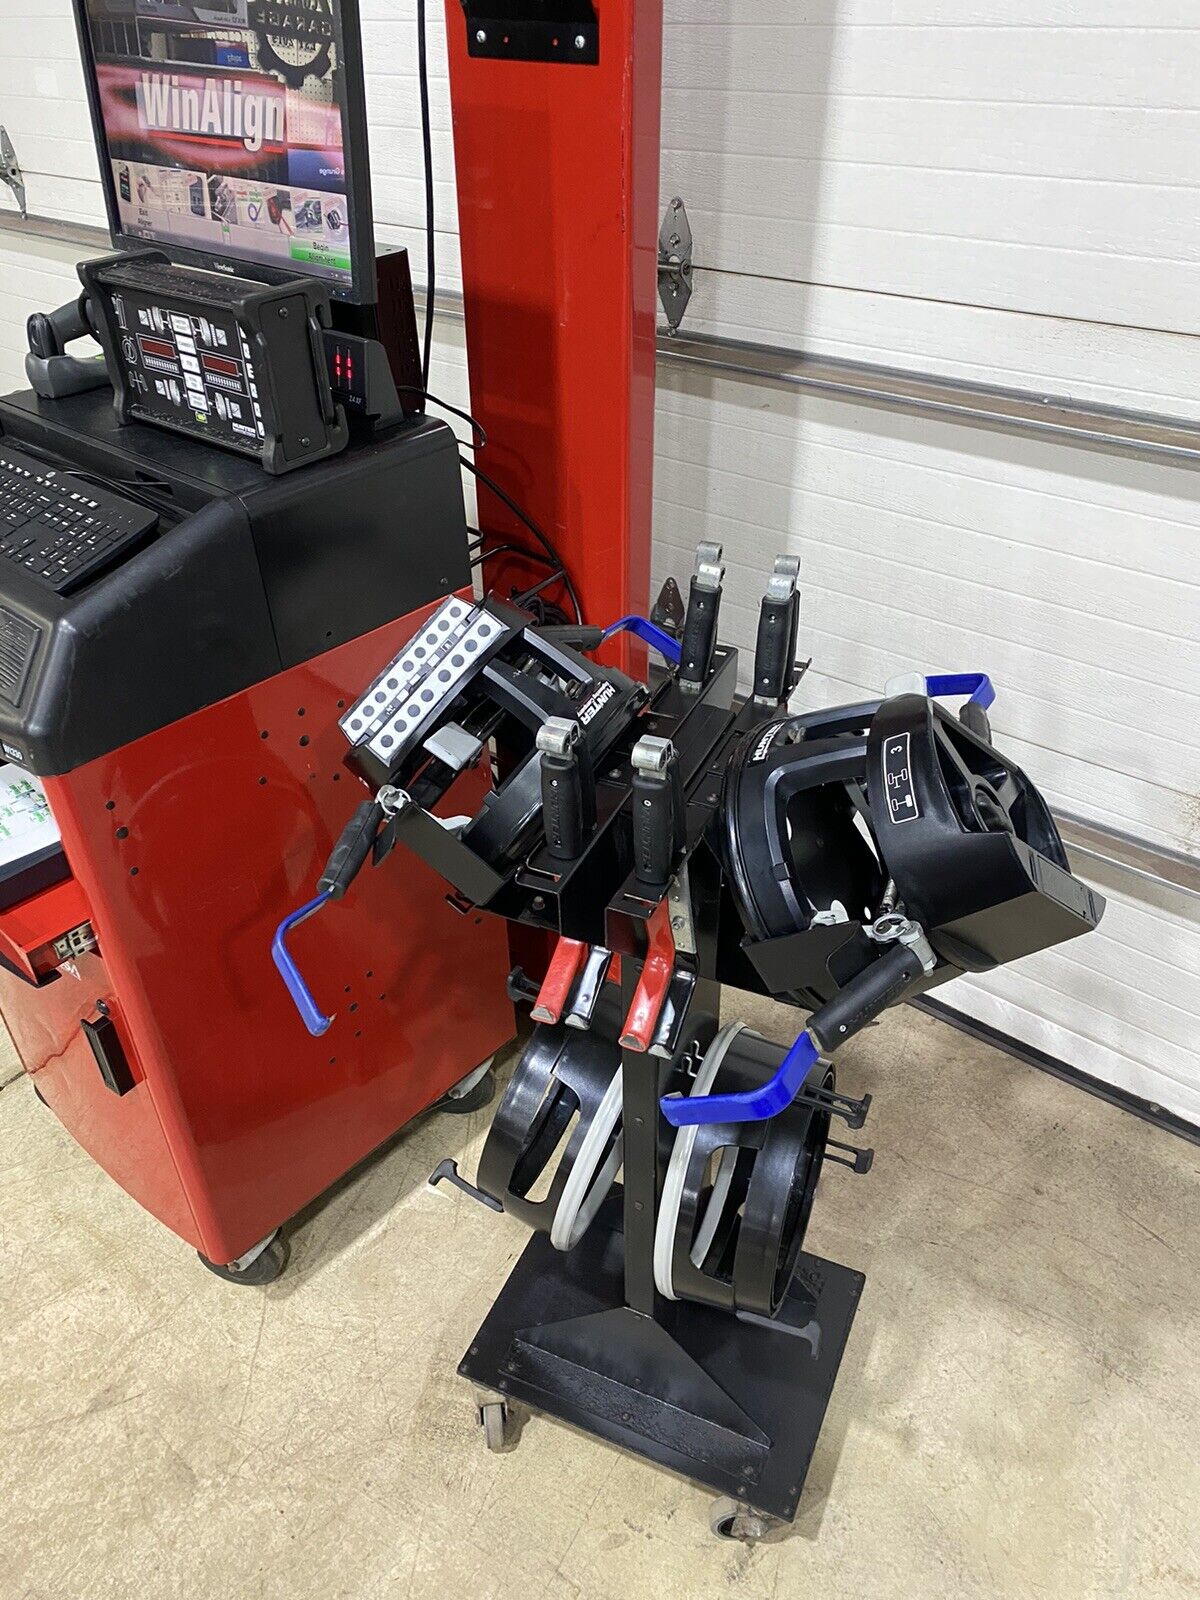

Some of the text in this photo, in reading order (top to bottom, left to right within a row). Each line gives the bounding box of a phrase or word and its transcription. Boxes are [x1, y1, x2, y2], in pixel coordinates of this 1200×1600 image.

[142, 73, 284, 151] WinAlign
[313, 242, 328, 250] Begin
[580, 681, 616, 725] HUNTER
[890, 745, 903, 754] 3
